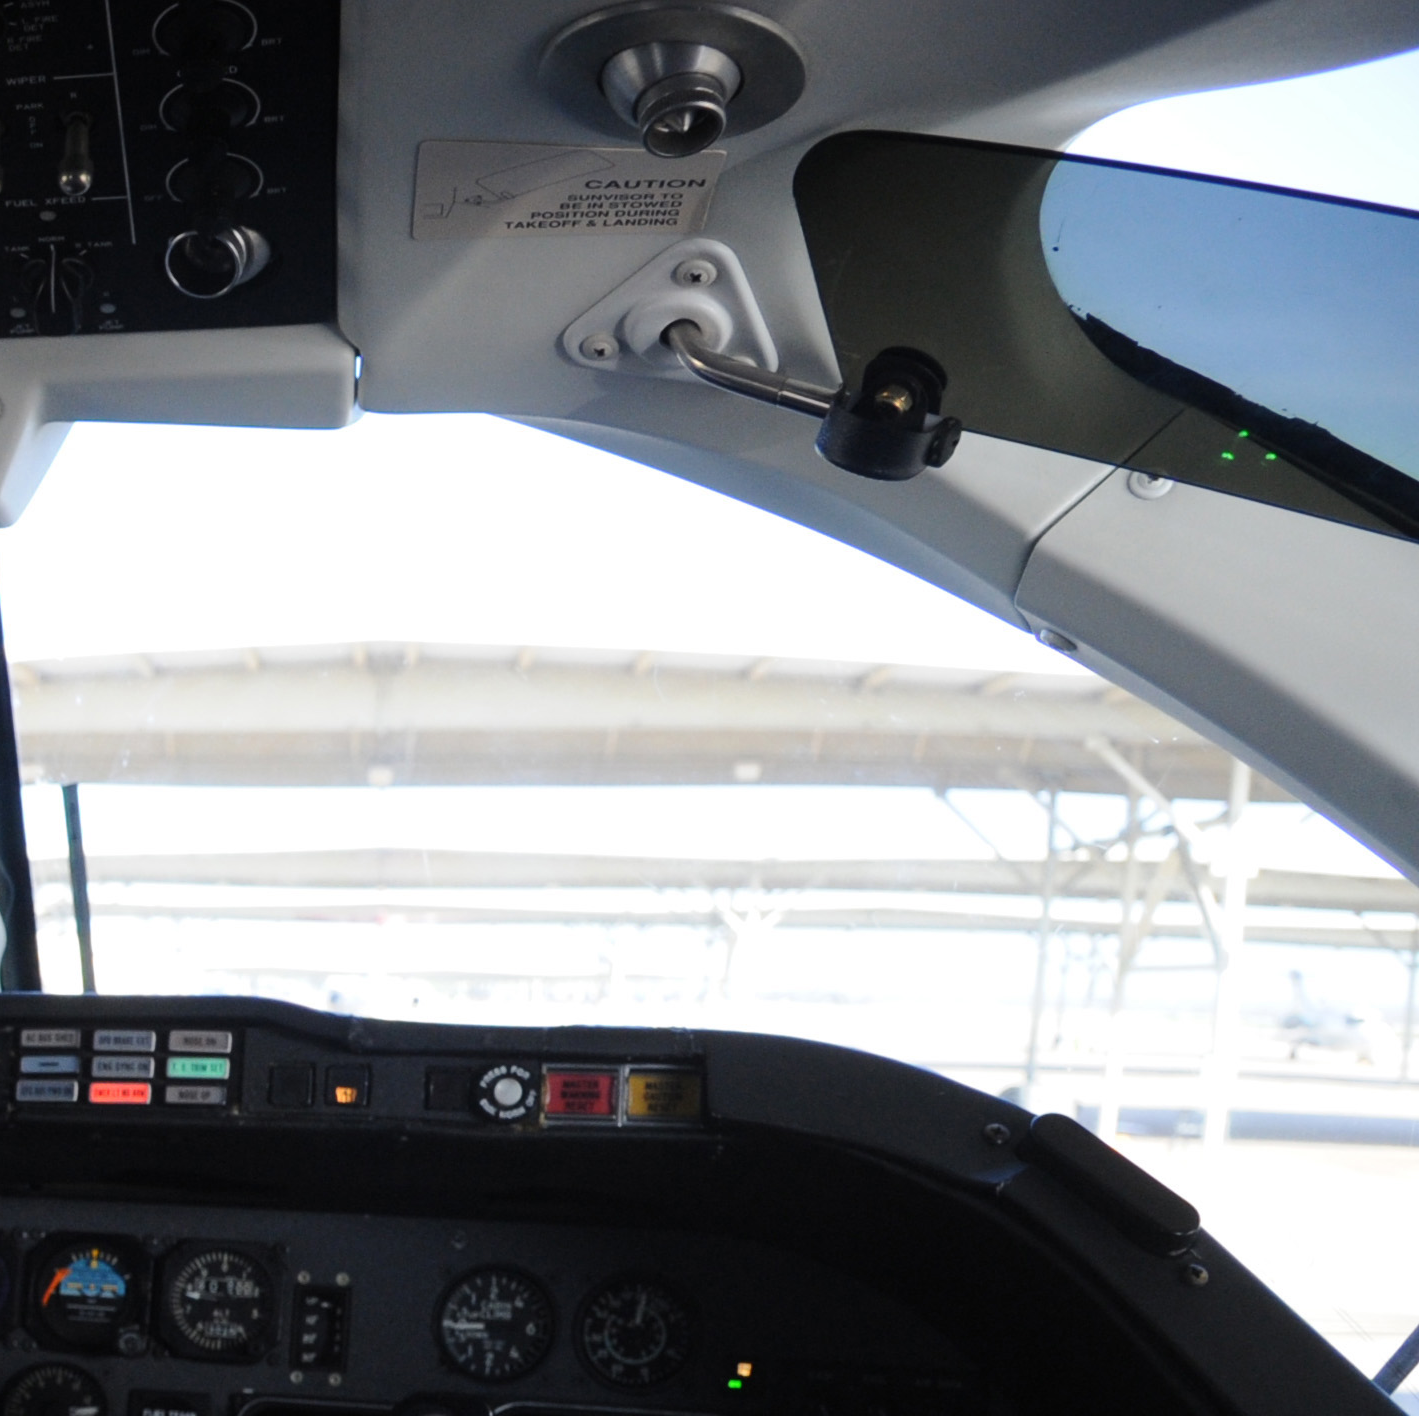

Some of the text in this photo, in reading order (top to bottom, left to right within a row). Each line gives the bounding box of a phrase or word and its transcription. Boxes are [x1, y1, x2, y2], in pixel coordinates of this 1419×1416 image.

[5, 74, 48, 87] WIPER
[15, 101, 45, 111] PARK
[584, 178, 708, 190] CAUTION
[4, 195, 88, 209] FUEL XFEED
[567, 191, 685, 202] SUNVISOR TO
[559, 199, 683, 211] BE IN STOWED
[530, 208, 681, 220] POSITION DURING
[504, 217, 679, 231] TAKEOFF & LANDING
[479, 1065, 531, 1088] PRESS FOR
[563, 1080, 599, 1090] MASTER
[644, 1081, 682, 1091] MASTER
[561, 1091, 601, 1101] WARNING
[565, 1102, 594, 1112] RESET
[647, 1103, 678, 1113] RESET
